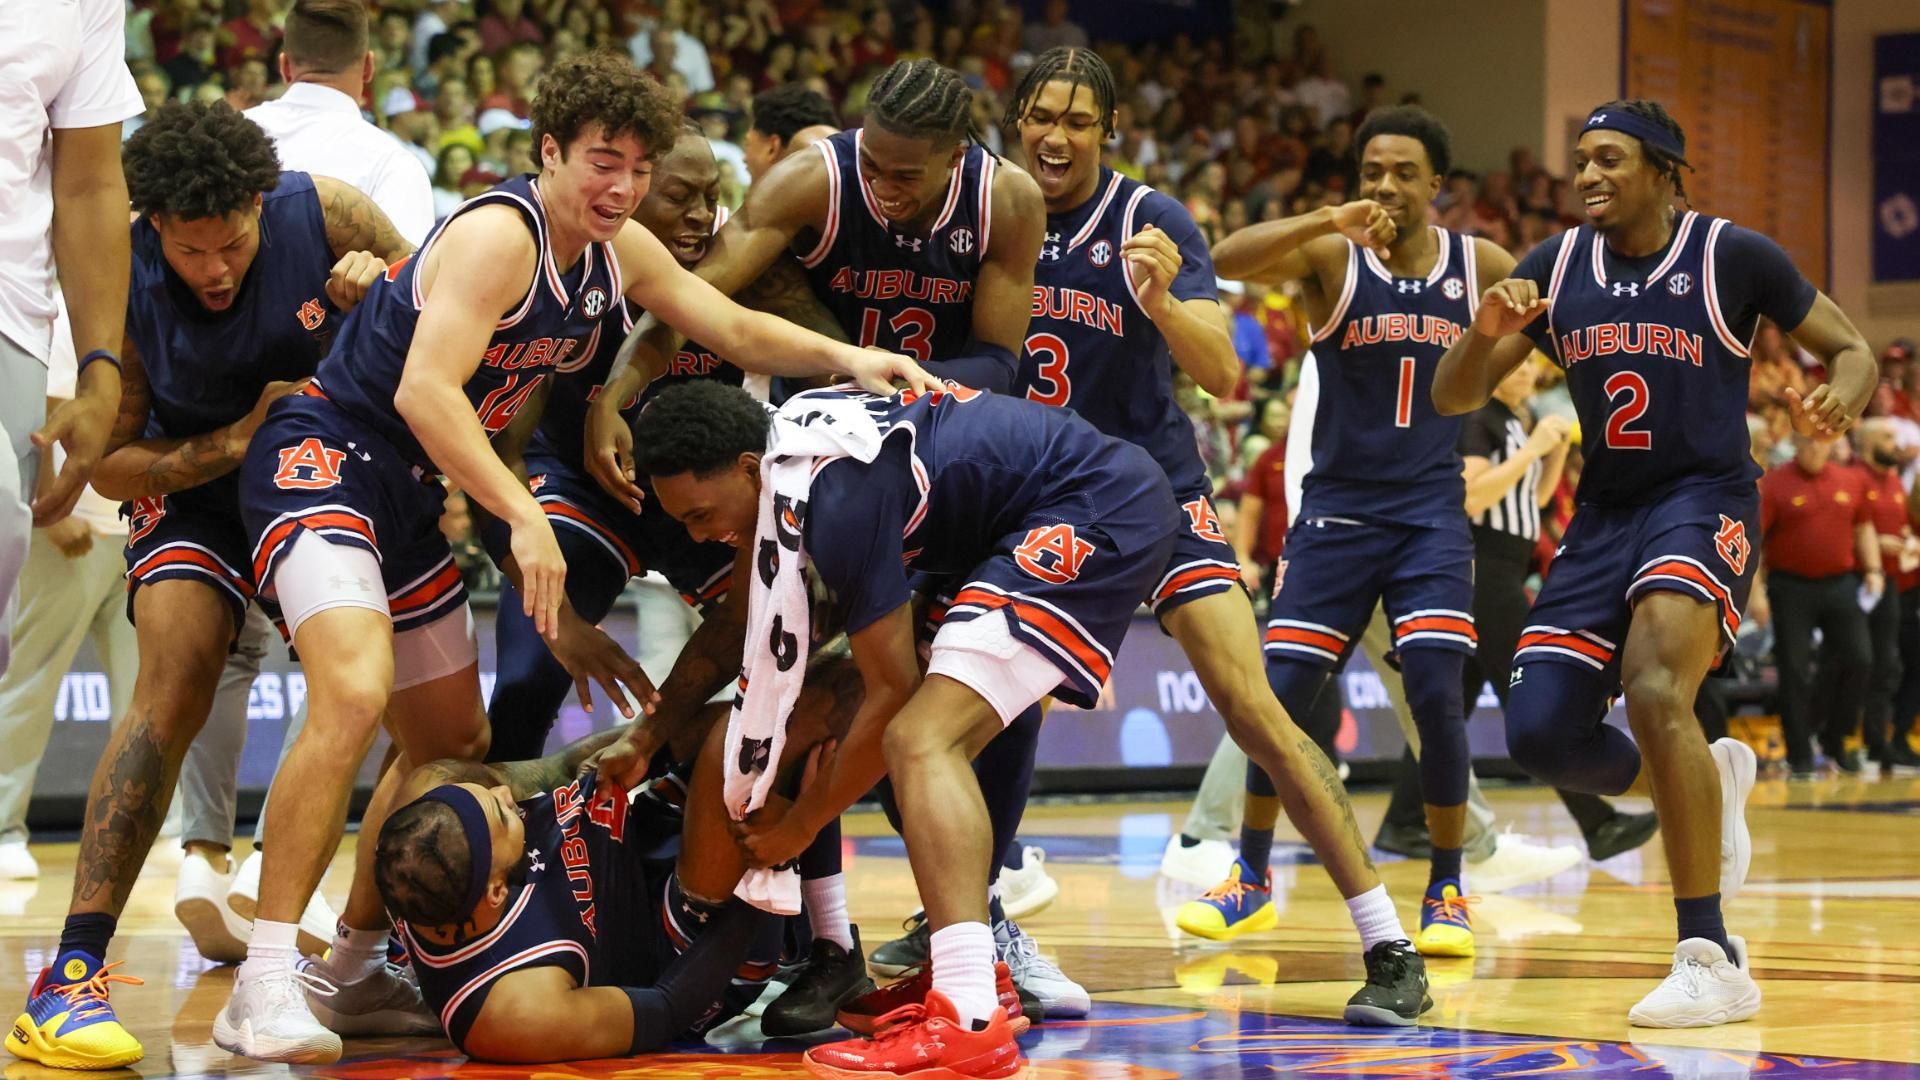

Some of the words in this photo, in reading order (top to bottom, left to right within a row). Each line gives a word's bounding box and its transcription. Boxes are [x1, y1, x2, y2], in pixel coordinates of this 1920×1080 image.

[949, 228, 974, 254] SEC
[1090, 241, 1111, 266] SEC
[584, 289, 606, 317] SEC
[1668, 273, 1692, 296] SEC
[859, 307, 936, 362] 13
[1561, 322, 1703, 368] AUBURN
[1024, 332, 1072, 408] 3
[1395, 356, 1416, 428] 1
[1603, 370, 1652, 451] 2
